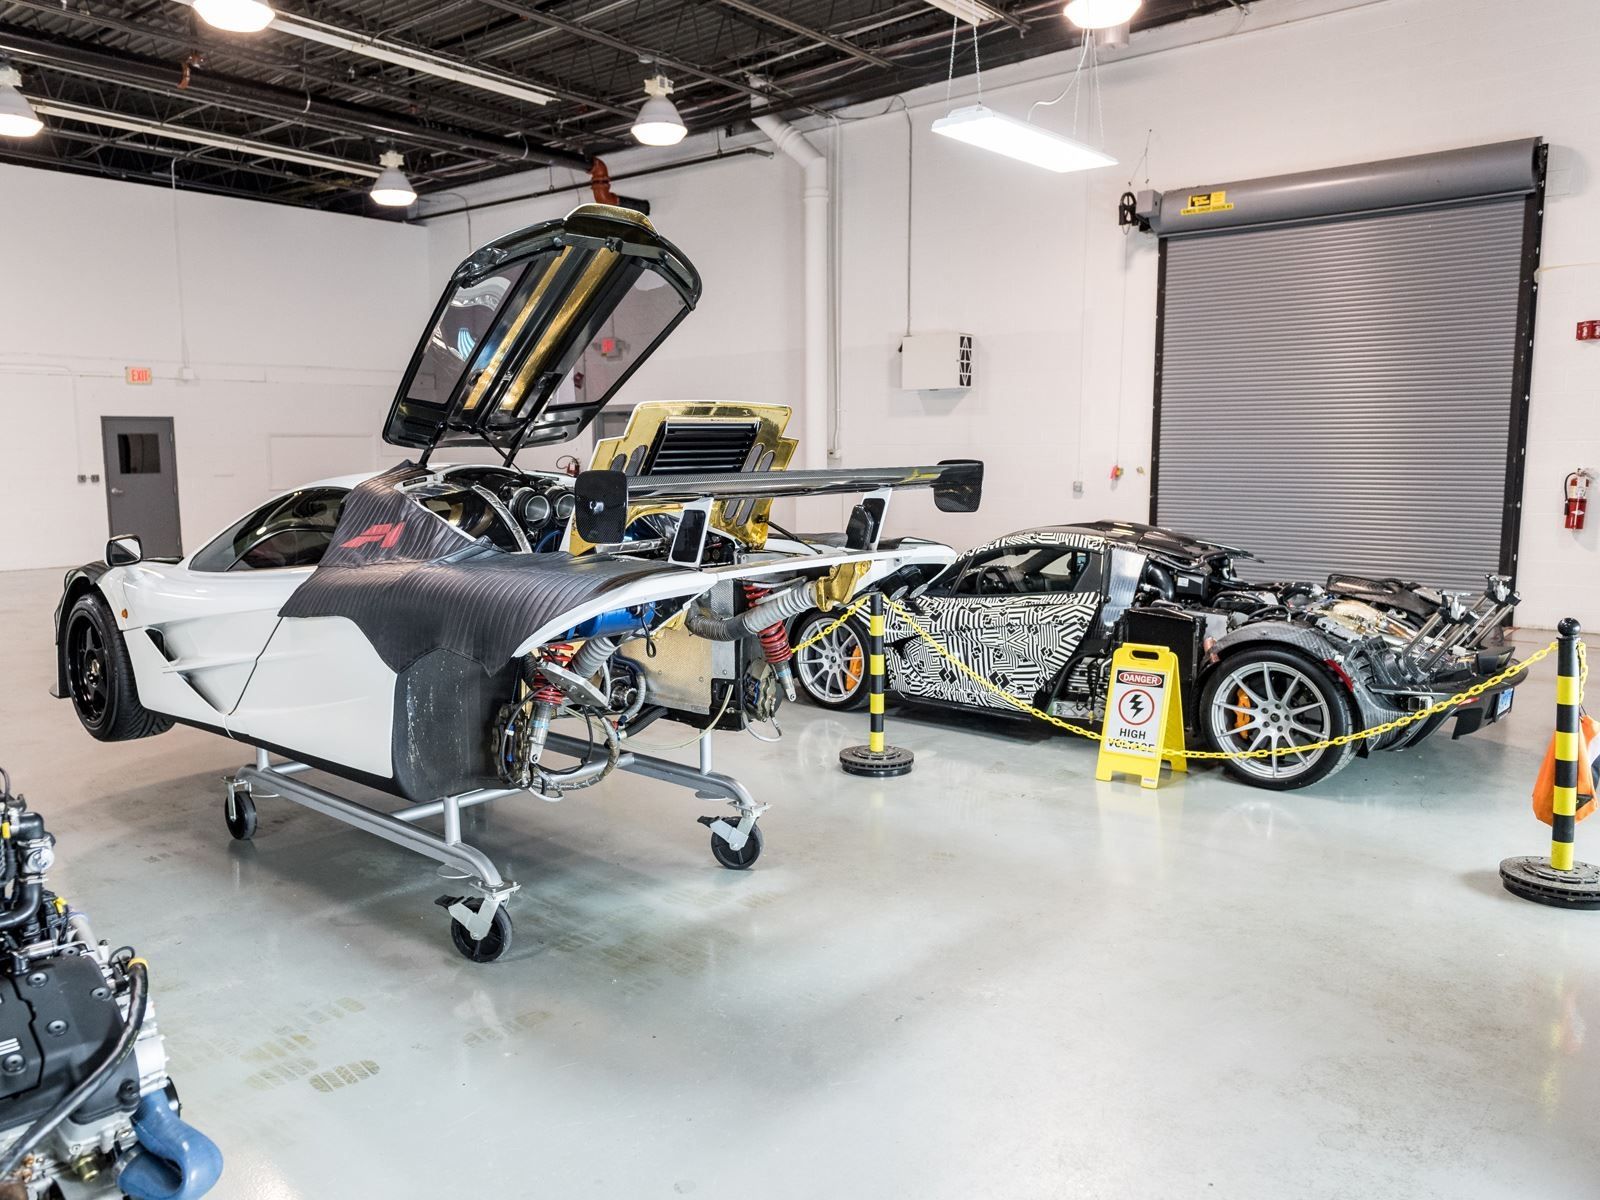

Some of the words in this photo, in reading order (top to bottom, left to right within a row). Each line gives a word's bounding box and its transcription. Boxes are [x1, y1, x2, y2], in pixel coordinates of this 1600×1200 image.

[131, 369, 149, 381] EXIT
[1123, 673, 1158, 685] DANGER
[1119, 728, 1146, 740] HIGH
